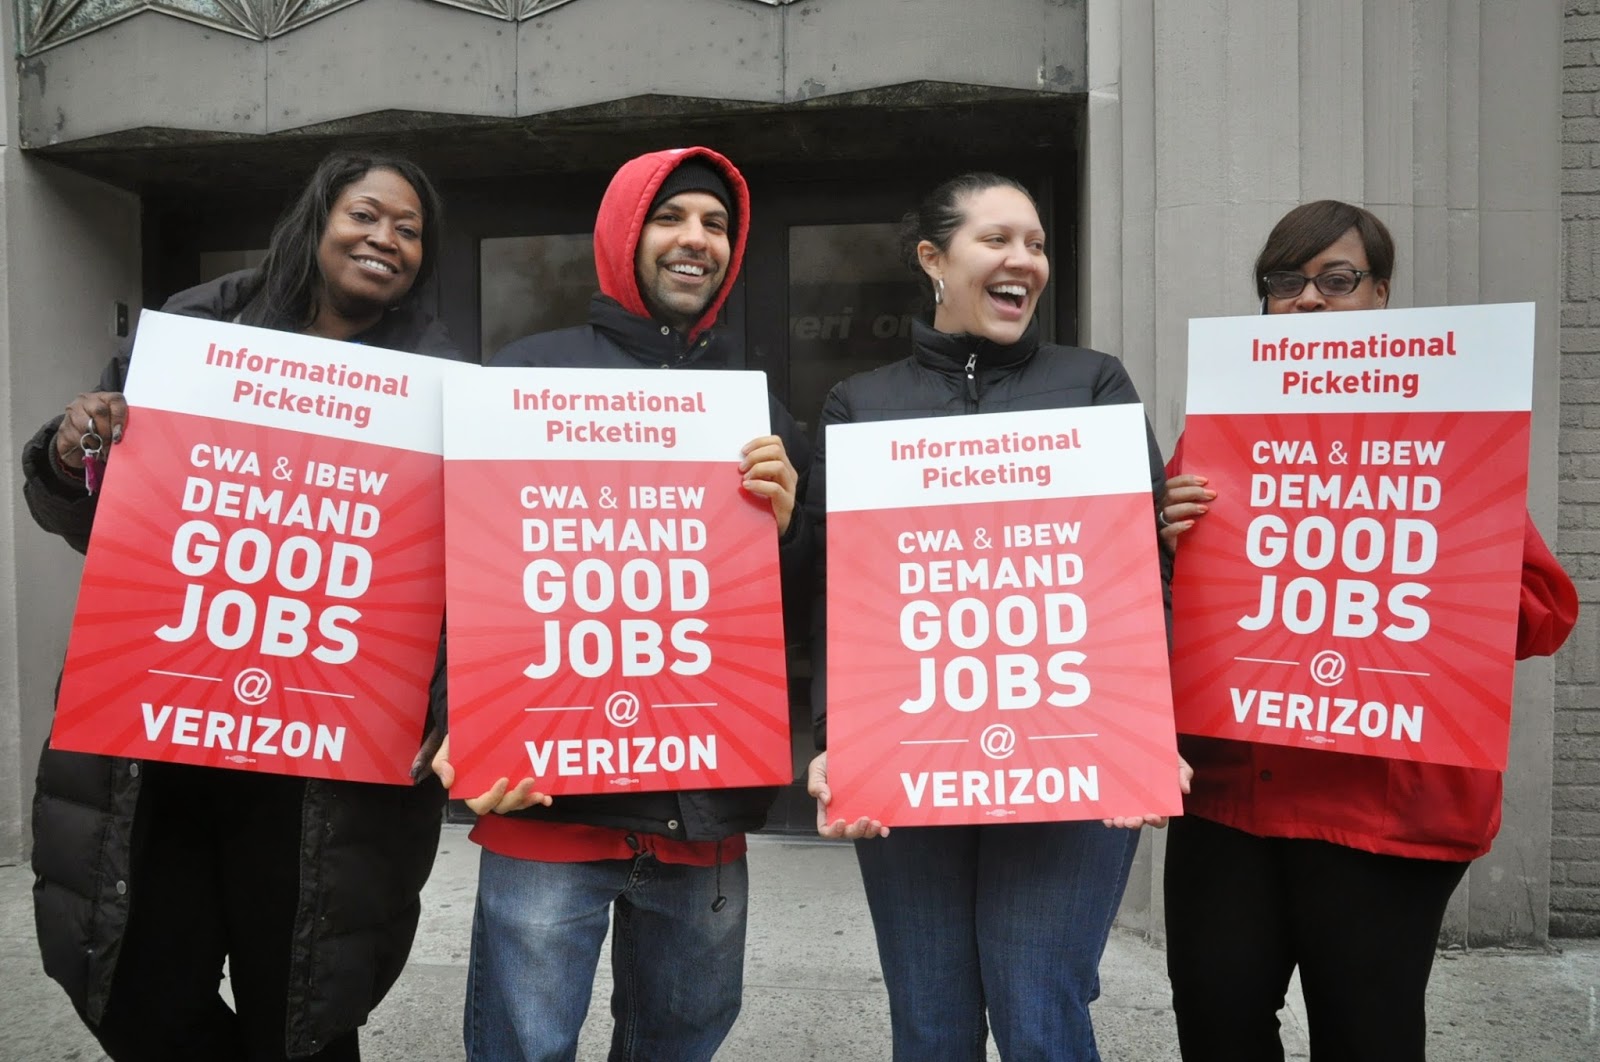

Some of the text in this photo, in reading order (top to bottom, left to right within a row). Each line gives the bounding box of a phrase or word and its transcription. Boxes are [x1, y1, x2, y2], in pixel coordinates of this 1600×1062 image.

[1253, 332, 1456, 361] Informational
[206, 343, 409, 398] Informational
[1283, 371, 1418, 398] Picketing
[233, 381, 371, 428] Picketing
[514, 389, 705, 412] Informational
[547, 421, 676, 448] Picketing
[892, 429, 1081, 460] Informational
[1253, 441, 1445, 465] CWA & IBEW
[191, 444, 388, 495] CWA & IBEW
[923, 463, 1050, 488] Picketing
[181, 478, 380, 538] DEMAND
[521, 486, 704, 509] CWA & IBEW
[1251, 474, 1441, 511] DEMAND
[523, 519, 706, 551] DEMAND
[898, 522, 1081, 553] CWA & IBEW
[1246, 515, 1437, 574] GOOD
[172, 520, 372, 599] GOOD
[900, 554, 1083, 594] DEMAND
[523, 558, 709, 613] GOOD
[155, 585, 361, 664] JOBS
[900, 593, 1087, 651] GOOD
[1237, 575, 1431, 641] JOBS
[523, 618, 711, 679] JOBS
[1310, 650, 1345, 686] @
[234, 668, 271, 705] @
[900, 651, 1090, 713] JOBS
[605, 691, 639, 727] @
[1230, 688, 1423, 743] VERIZON
[142, 703, 346, 763] VERIZON
[980, 724, 1015, 759] @
[525, 735, 717, 777] VERIZON
[900, 766, 1099, 807] VERIZON
